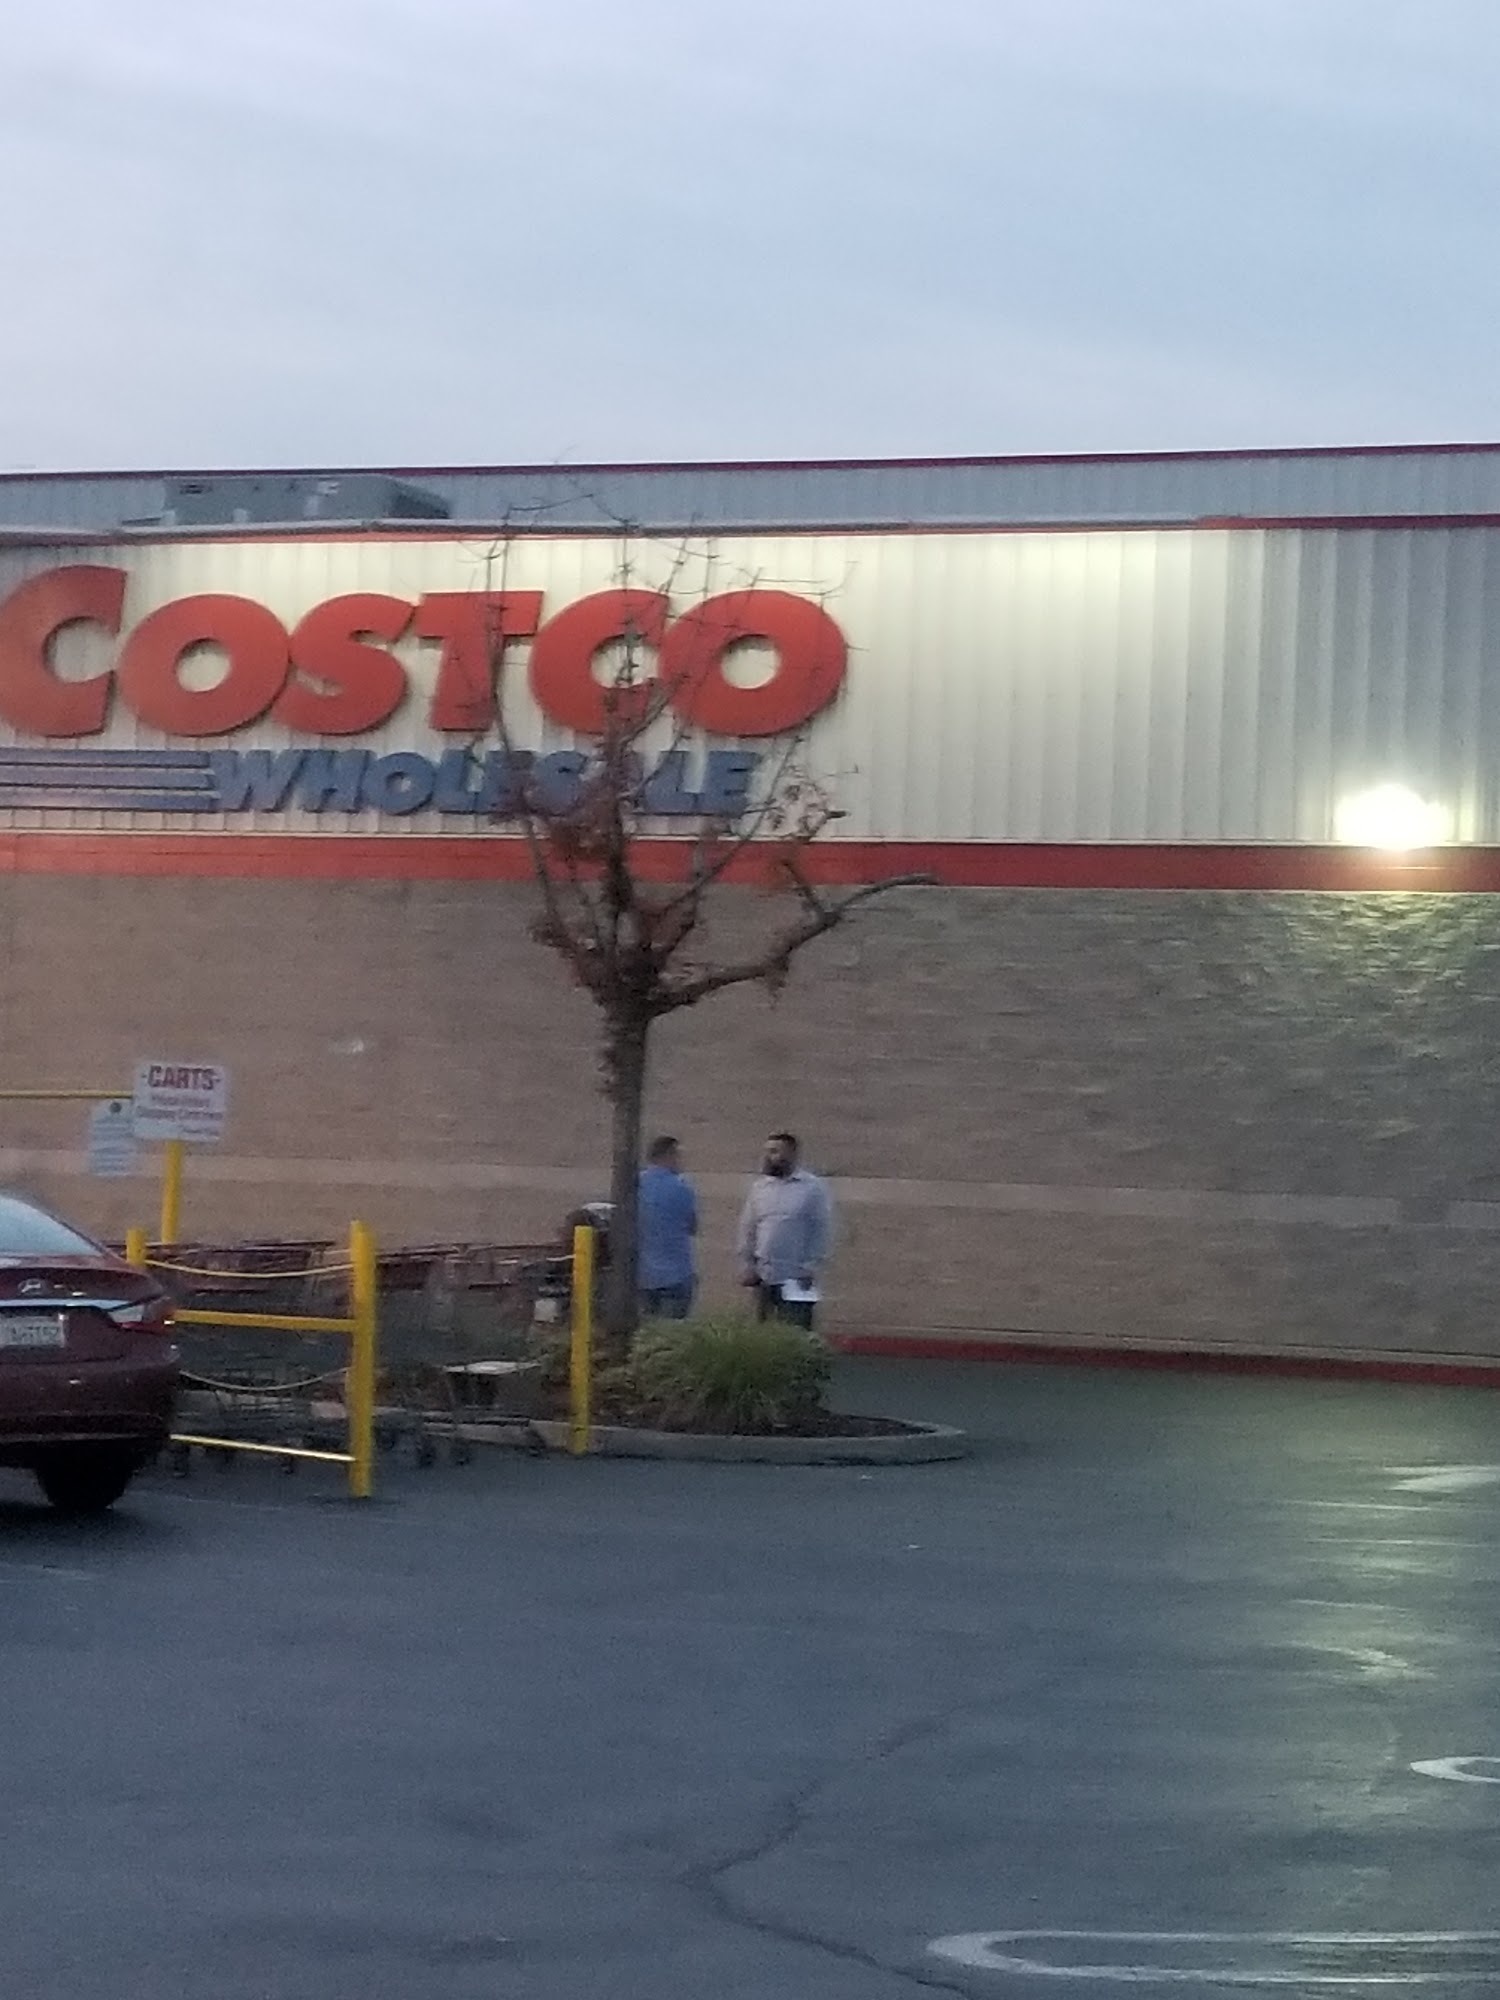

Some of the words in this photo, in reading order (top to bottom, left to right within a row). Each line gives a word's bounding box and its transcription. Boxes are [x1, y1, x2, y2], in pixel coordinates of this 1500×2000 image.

[0, 564, 848, 737] COSTCO
[209, 748, 761, 816] WHOLESLE
[149, 1065, 214, 1090] CARTS
